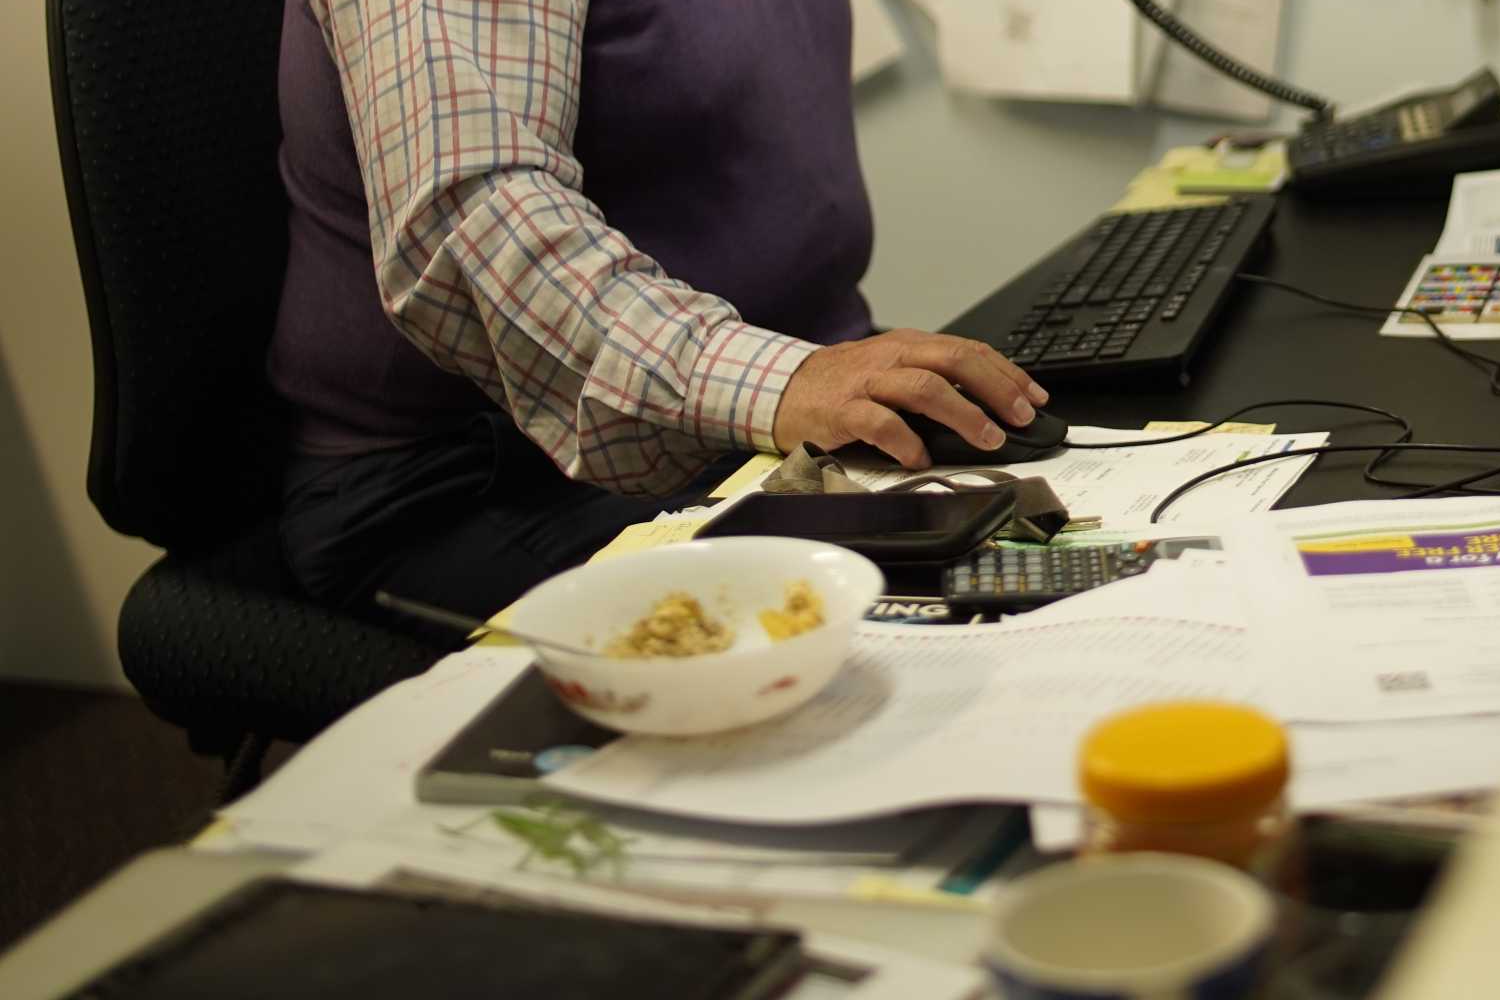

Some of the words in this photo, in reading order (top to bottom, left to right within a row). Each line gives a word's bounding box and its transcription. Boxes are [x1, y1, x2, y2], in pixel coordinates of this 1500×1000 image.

[1393, 546, 1459, 559] FREE
[1448, 552, 1493, 565] for
[1425, 555, 1443, 565] a
